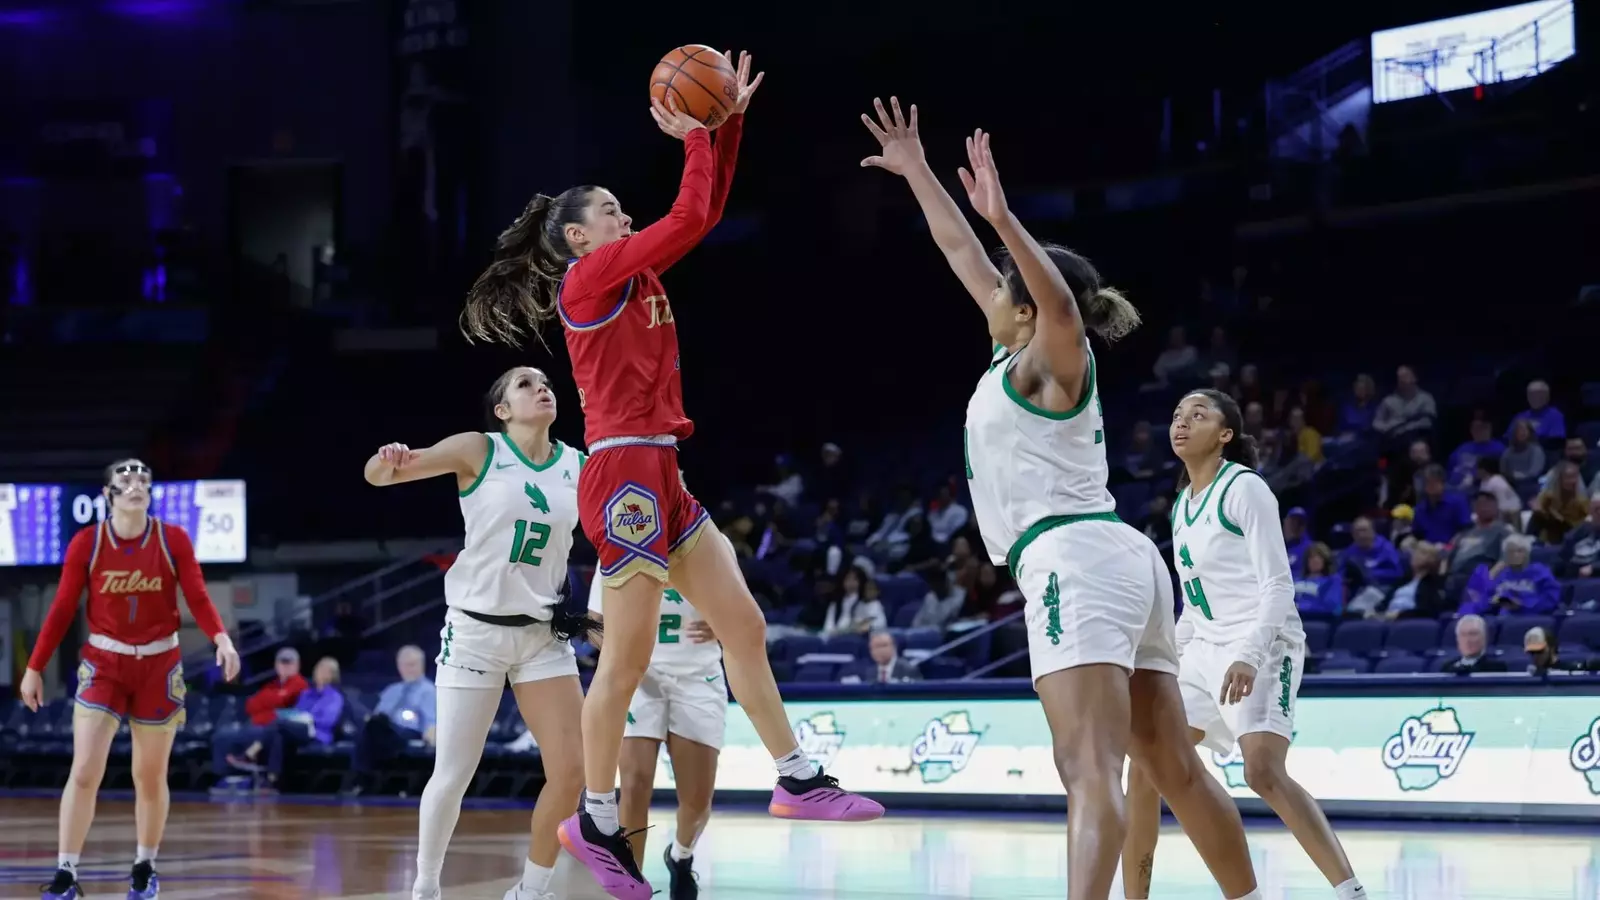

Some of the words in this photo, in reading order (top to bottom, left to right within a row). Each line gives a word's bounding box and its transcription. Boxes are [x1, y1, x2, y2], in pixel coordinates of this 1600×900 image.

[205, 513, 234, 533] 50
[616, 511, 652, 527] Tulsa
[509, 519, 551, 566] 12
[100, 570, 162, 594] Tulsa
[1184, 577, 1213, 620] 4
